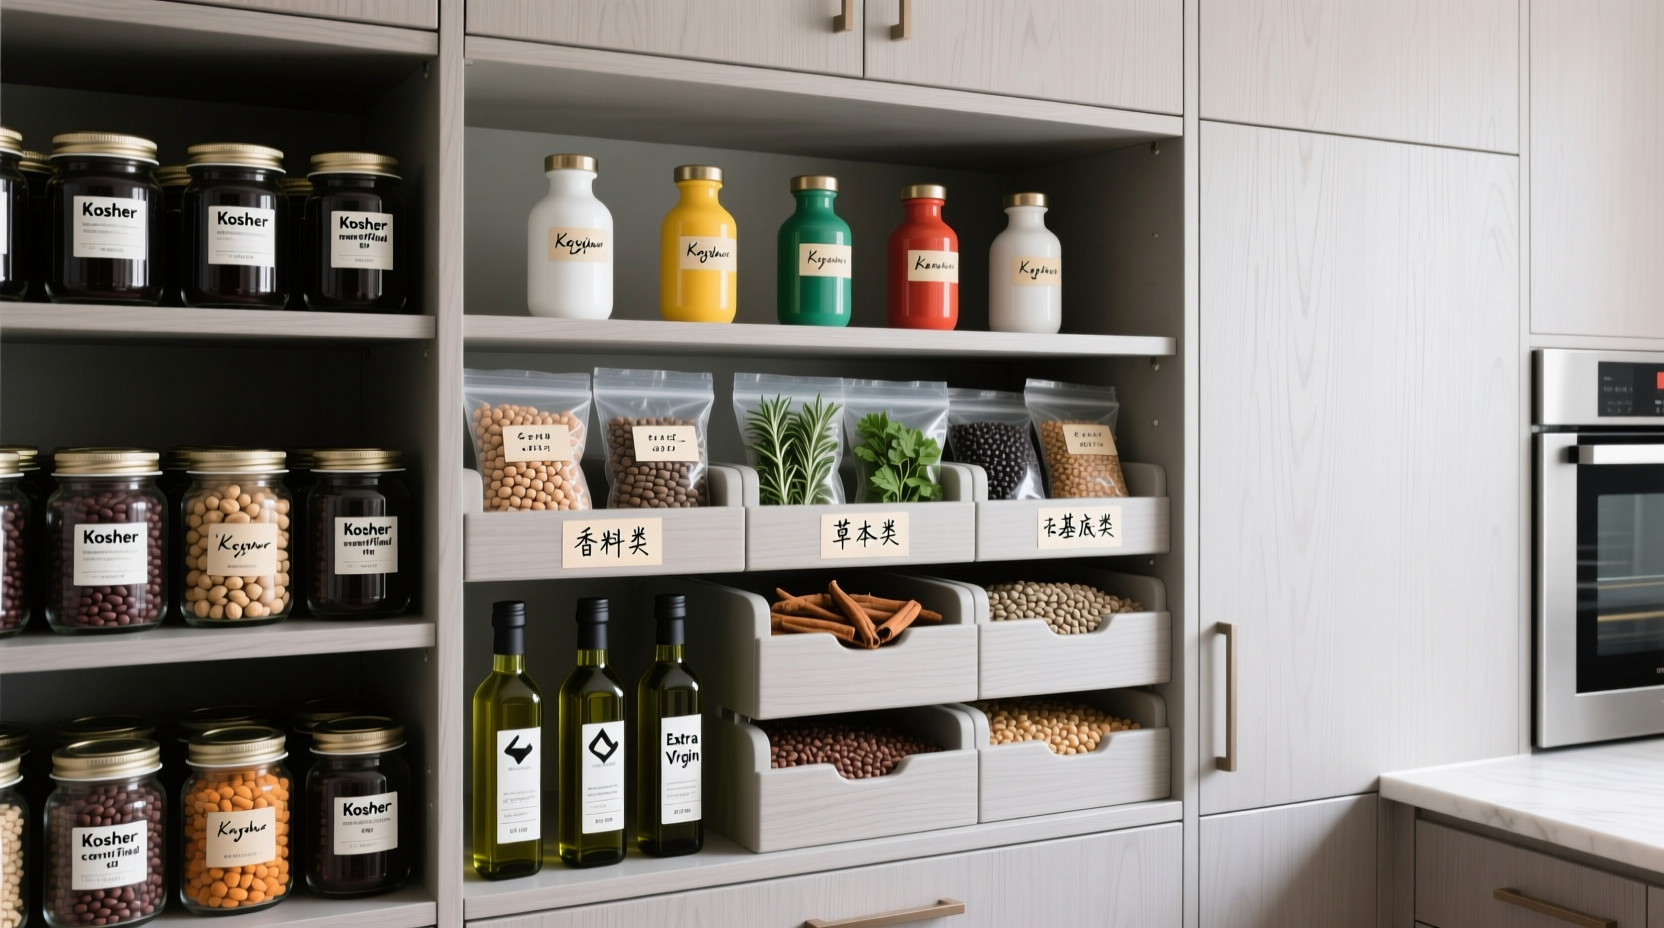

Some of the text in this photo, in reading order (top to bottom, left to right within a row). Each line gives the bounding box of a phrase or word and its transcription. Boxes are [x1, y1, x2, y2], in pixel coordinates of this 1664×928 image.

[82, 201, 138, 219] Kosher
[216, 211, 269, 228] Kosher
[339, 215, 388, 231] Kosher
[83, 529, 139, 545] Kosher
[575, 525, 649, 559] 香料类
[832, 518, 900, 550] 草本类
[666, 732, 699, 746] Extra
[342, 801, 393, 817] Kosher
[81, 831, 139, 848] Kosher
